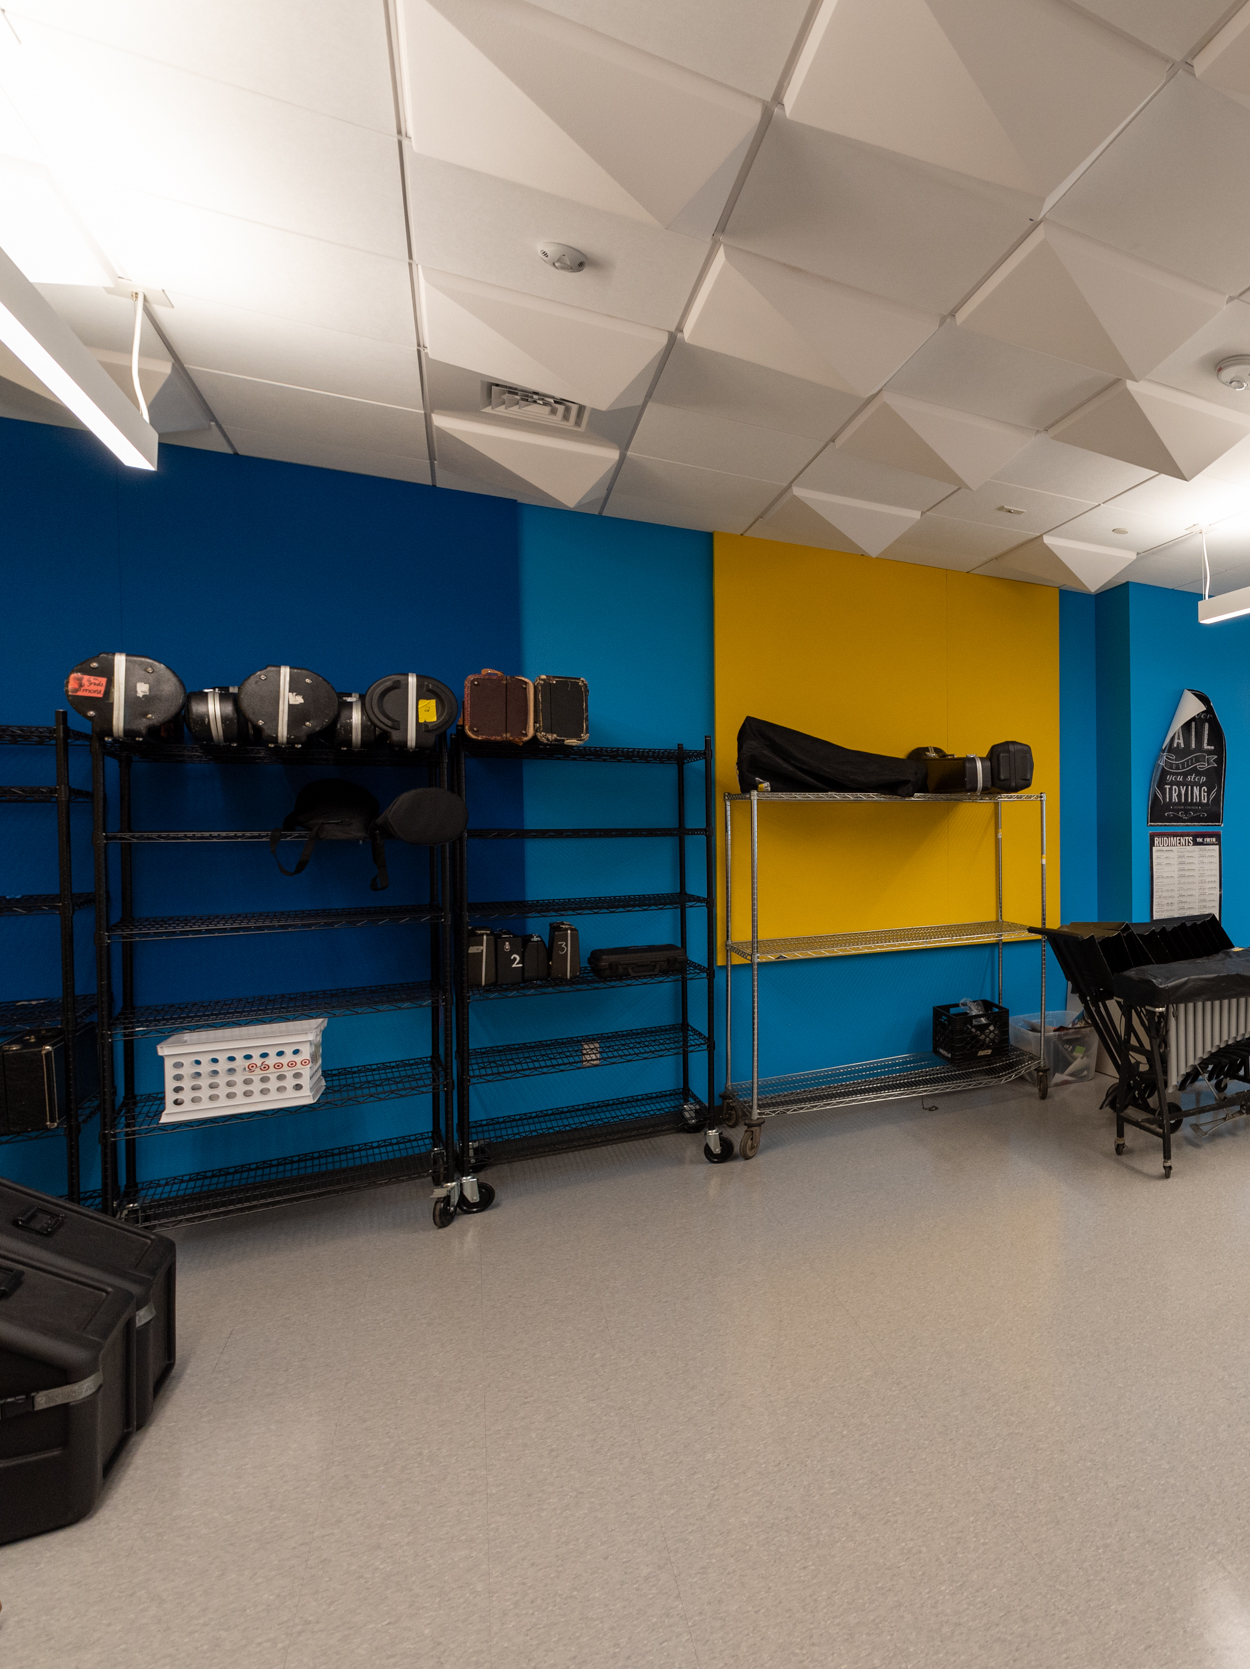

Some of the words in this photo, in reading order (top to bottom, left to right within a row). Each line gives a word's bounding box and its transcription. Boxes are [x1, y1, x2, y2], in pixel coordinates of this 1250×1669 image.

[1172, 721, 1214, 750] AIL
[1166, 774, 1184, 783] you
[1186, 773, 1207, 784] stop
[1164, 784, 1208, 803] TRYING
[1154, 836, 1193, 847] RUDIMENTS
[557, 941, 567, 955] 3
[511, 954, 523, 968] 2
